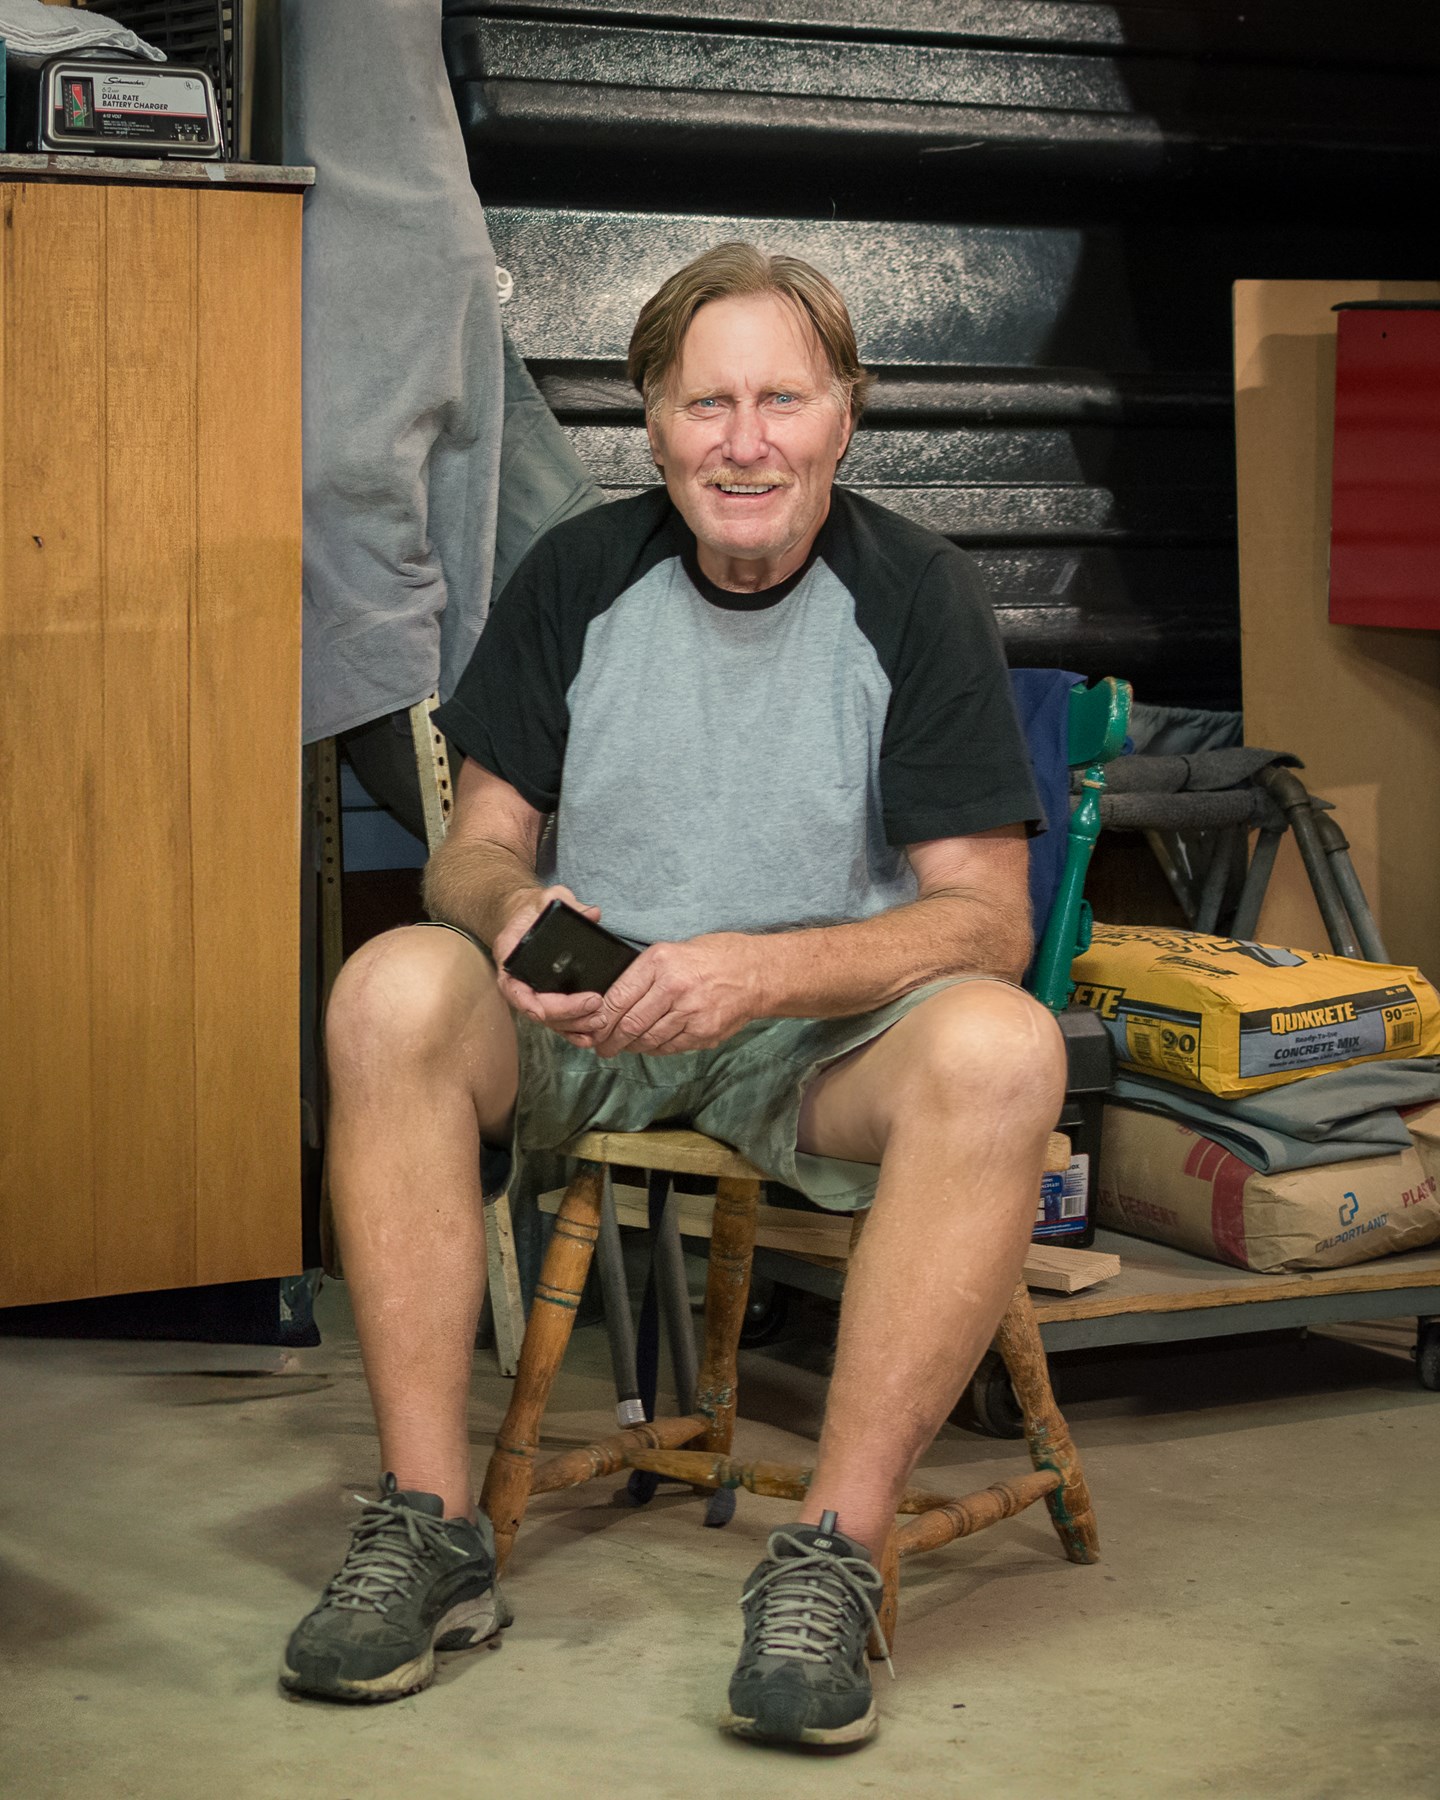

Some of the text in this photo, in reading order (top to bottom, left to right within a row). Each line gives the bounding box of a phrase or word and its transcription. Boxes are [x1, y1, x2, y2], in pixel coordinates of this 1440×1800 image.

[103, 77, 145, 86] Schumacher
[102, 100, 169, 110] BATTERY CHARGER
[1271, 1001, 1357, 1035] QUIKRETE
[1385, 1008, 1402, 1022] 90
[1161, 1028, 1196, 1054] 90
[1274, 1041, 1335, 1060] CONCRETE
[1337, 1036, 1360, 1049] MIX
[1315, 1213, 1388, 1253] CALPORTLAND
